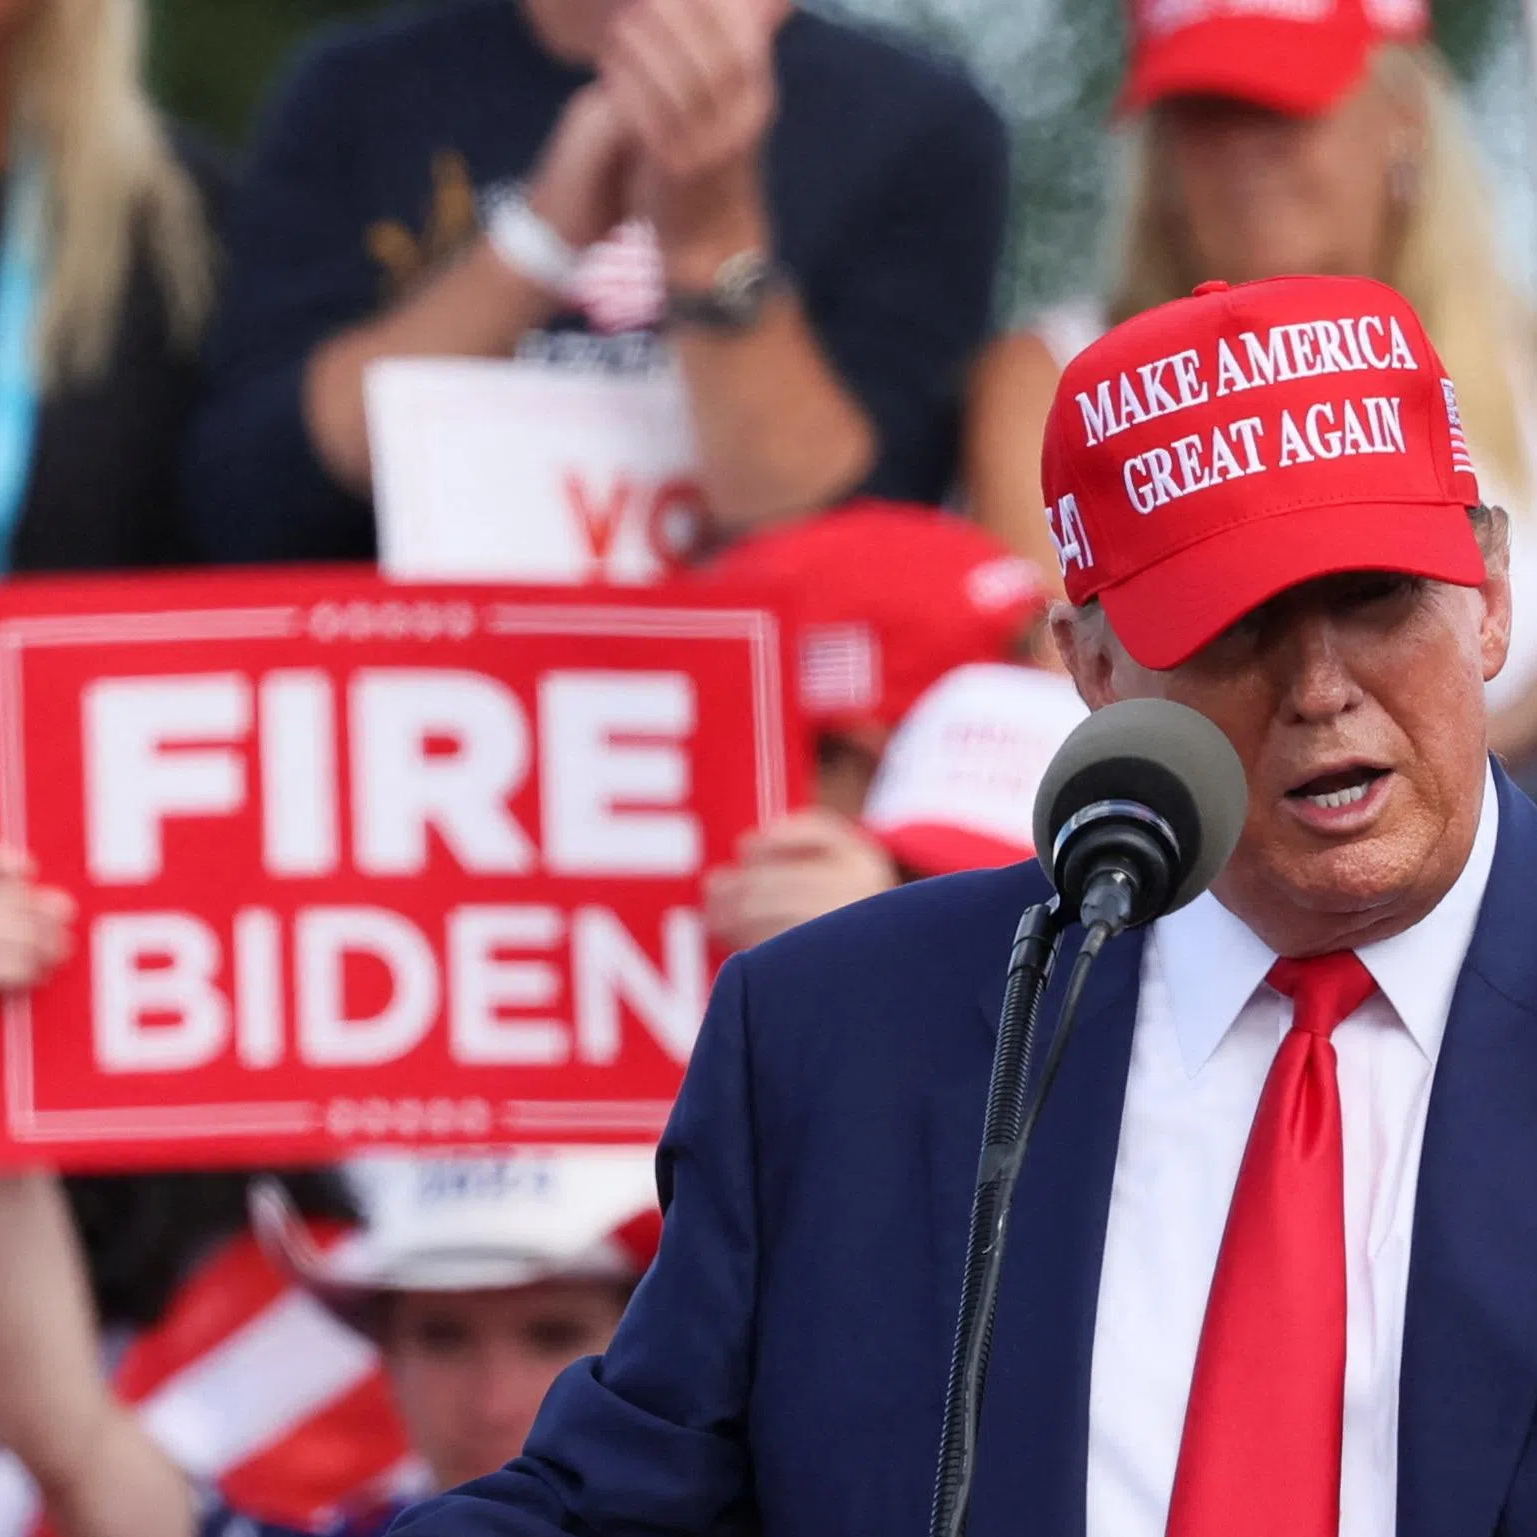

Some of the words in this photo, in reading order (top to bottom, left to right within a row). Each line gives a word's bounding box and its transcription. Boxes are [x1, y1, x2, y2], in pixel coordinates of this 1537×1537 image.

[1074, 348, 1209, 448] MAKE
[1216, 315, 1419, 397] AMERICA
[1122, 416, 1267, 515] GREAT
[1278, 397, 1407, 467] AGAIN
[81, 666, 705, 886] FIRE
[90, 902, 708, 1074] BIDEN
